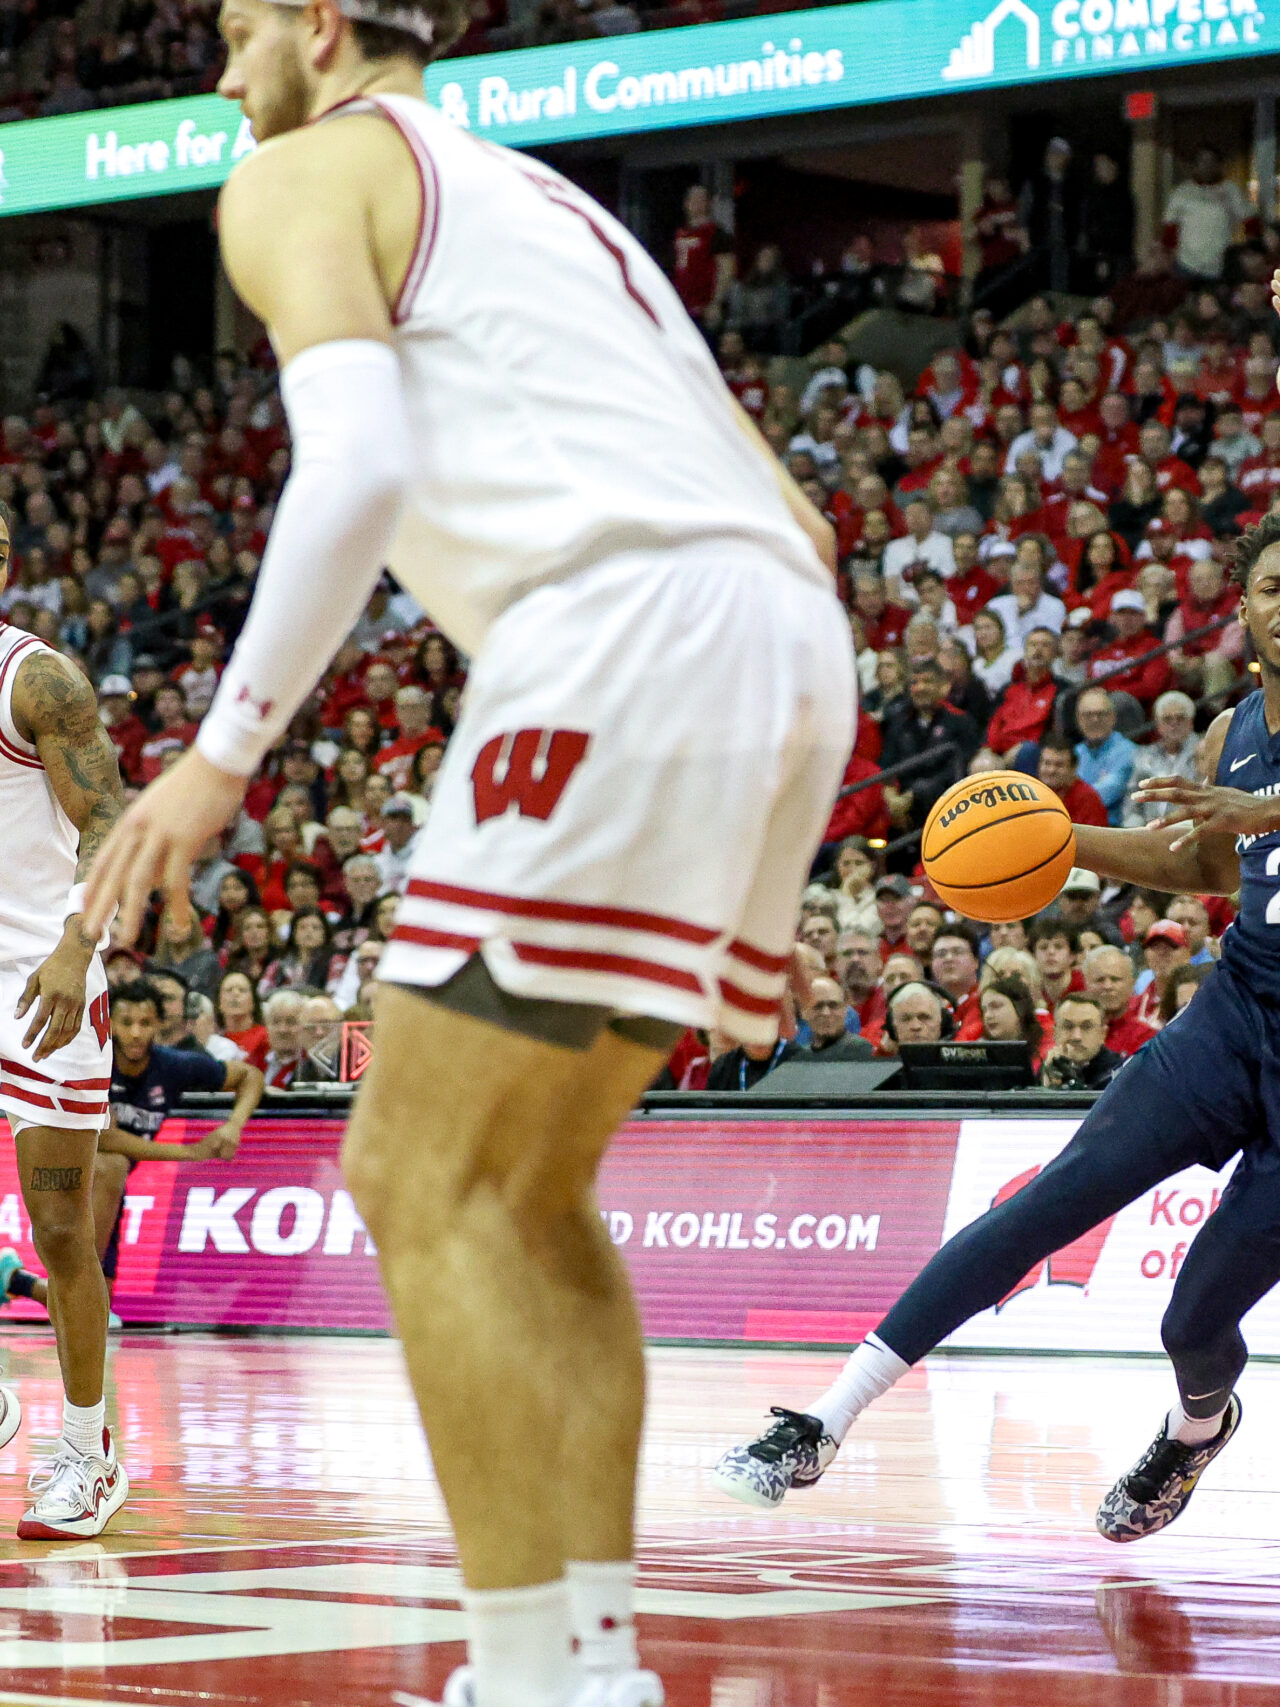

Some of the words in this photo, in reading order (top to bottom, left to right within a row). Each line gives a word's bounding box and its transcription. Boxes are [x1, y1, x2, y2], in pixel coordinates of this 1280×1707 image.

[1052, 16, 1261, 67] FINANCIAL
[86, 130, 170, 180] Here
[175, 119, 228, 167] for
[440, 82, 470, 127] &
[478, 66, 577, 127] Rural
[584, 37, 844, 112] Communities
[471, 728, 590, 825] W
[939, 783, 1041, 828] Wilson
[31, 1166, 82, 1192] ABOVE
[642, 1211, 881, 1251] KOHLS.COM
[1141, 1242, 1187, 1280] of
